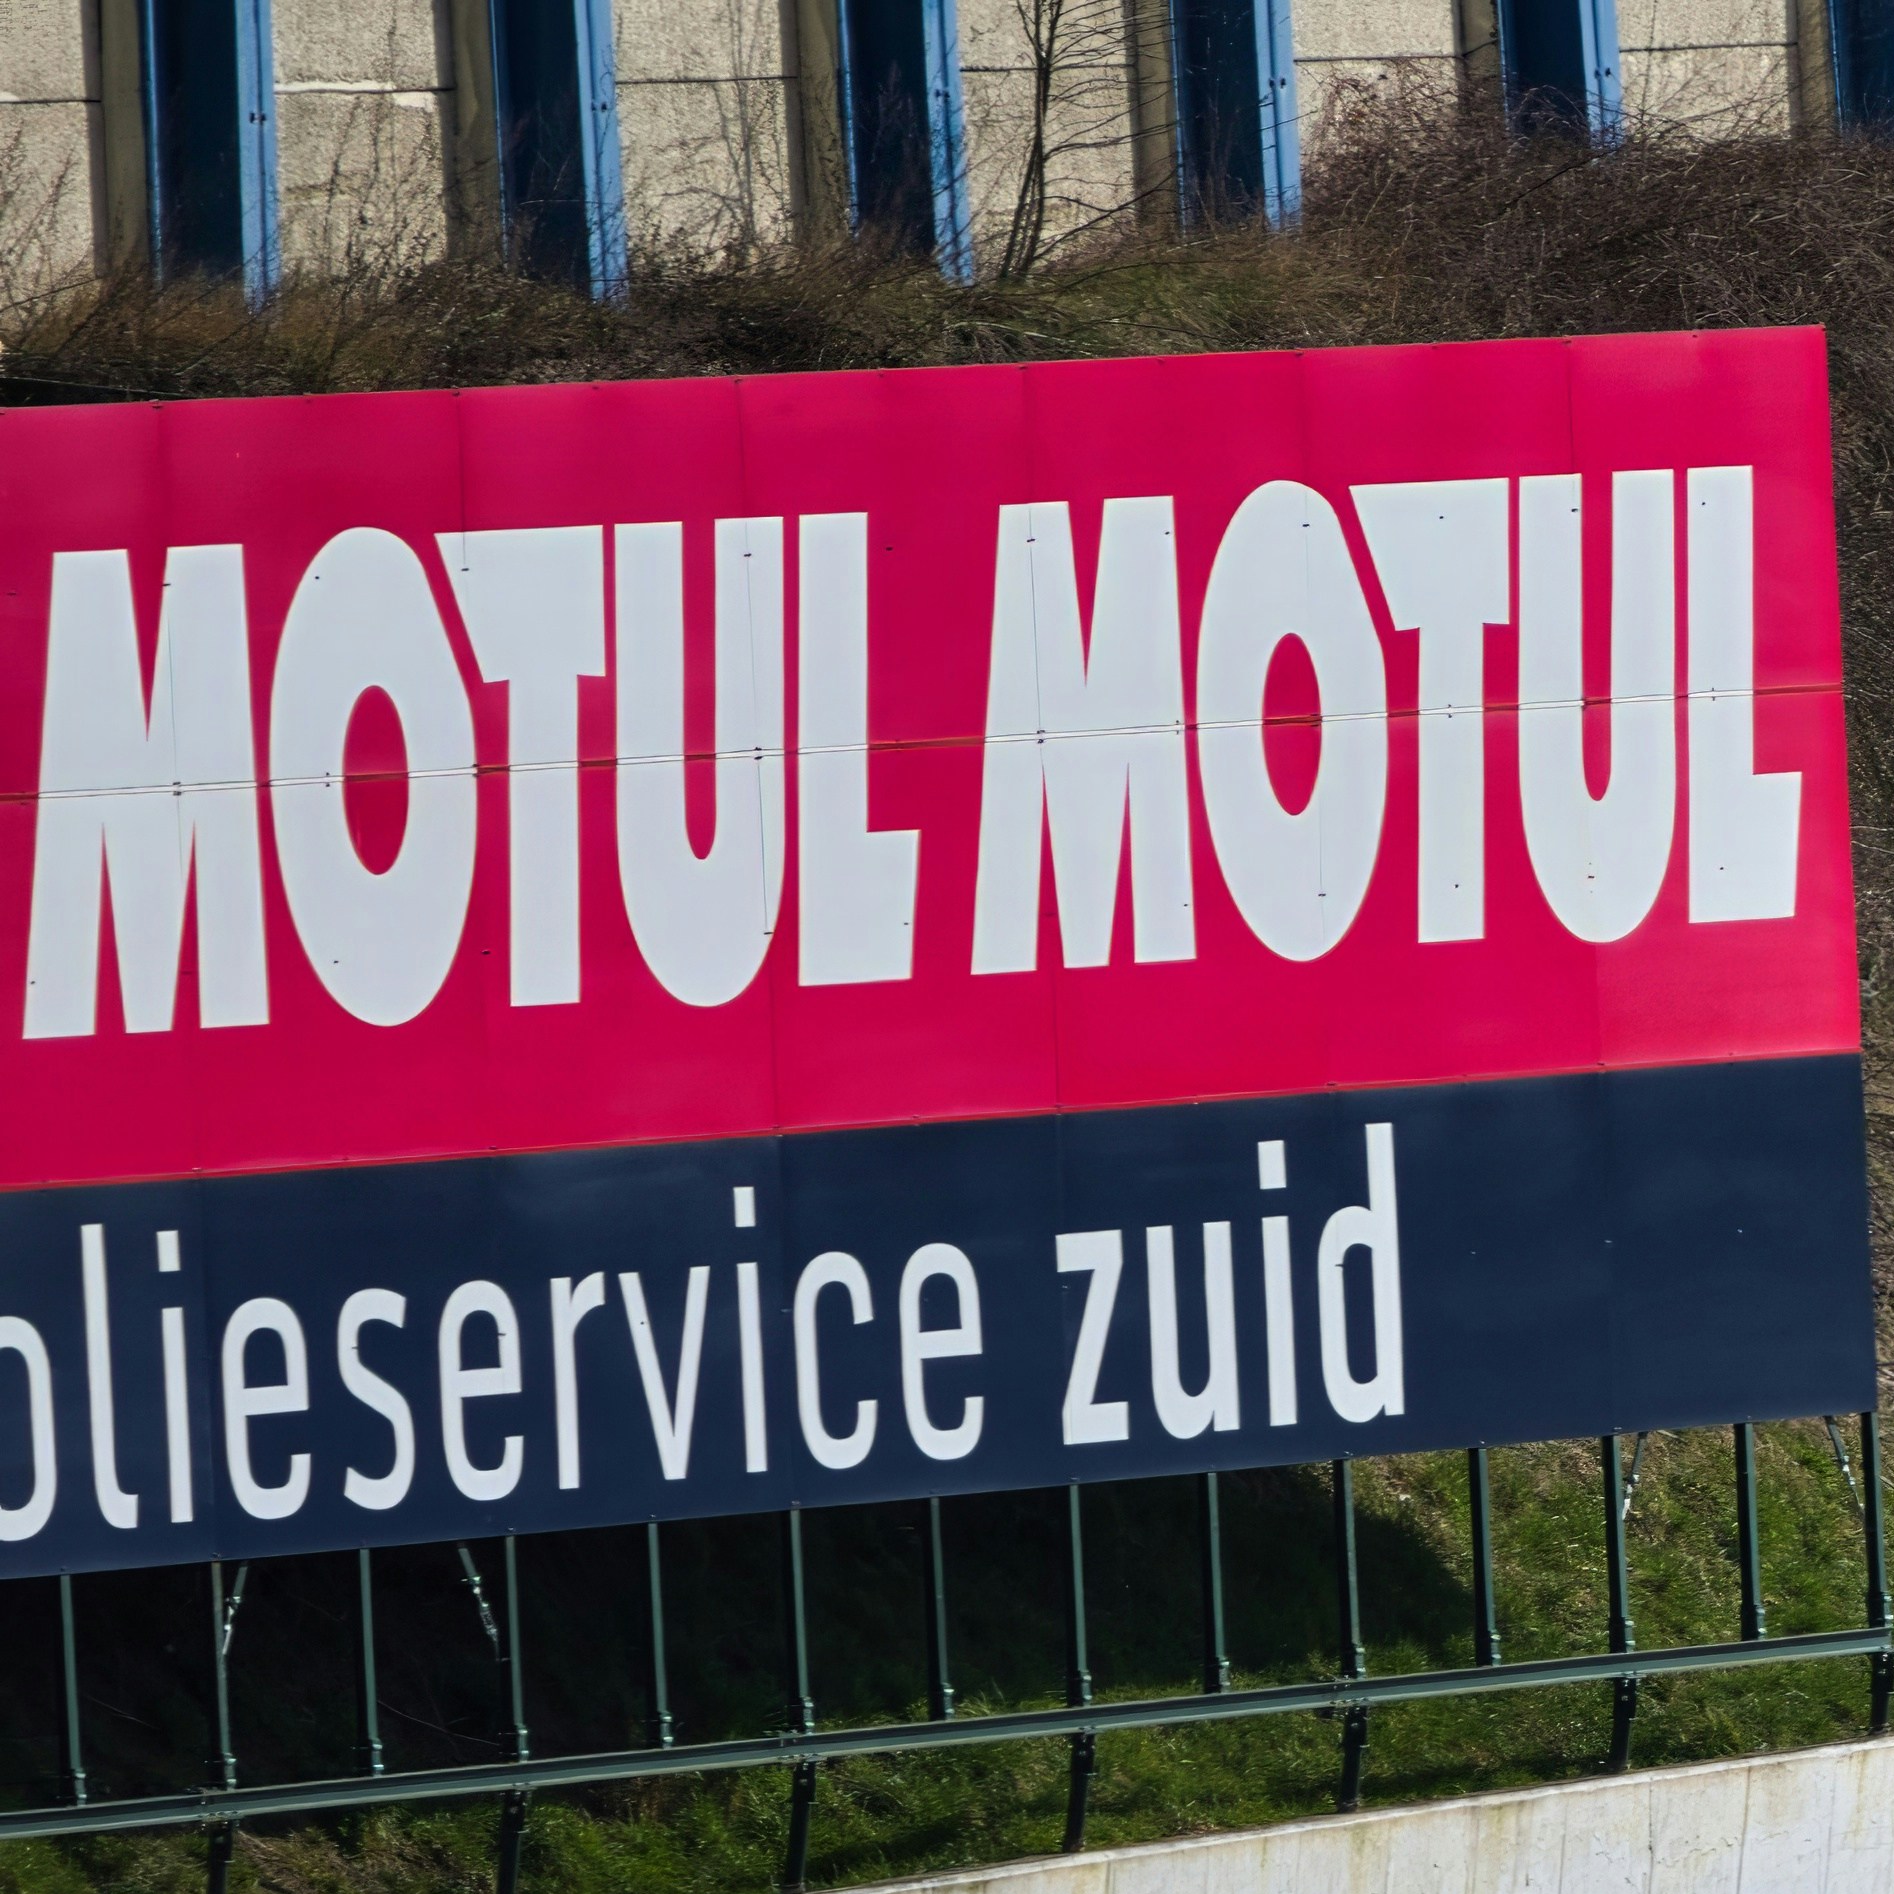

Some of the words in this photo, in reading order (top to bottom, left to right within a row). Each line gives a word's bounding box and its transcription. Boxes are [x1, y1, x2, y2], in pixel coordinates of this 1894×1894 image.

[23, 512, 919, 1038] MOTUL
[970, 465, 1803, 975] MOTUL
[1055, 1122, 1407, 1447] zuid
